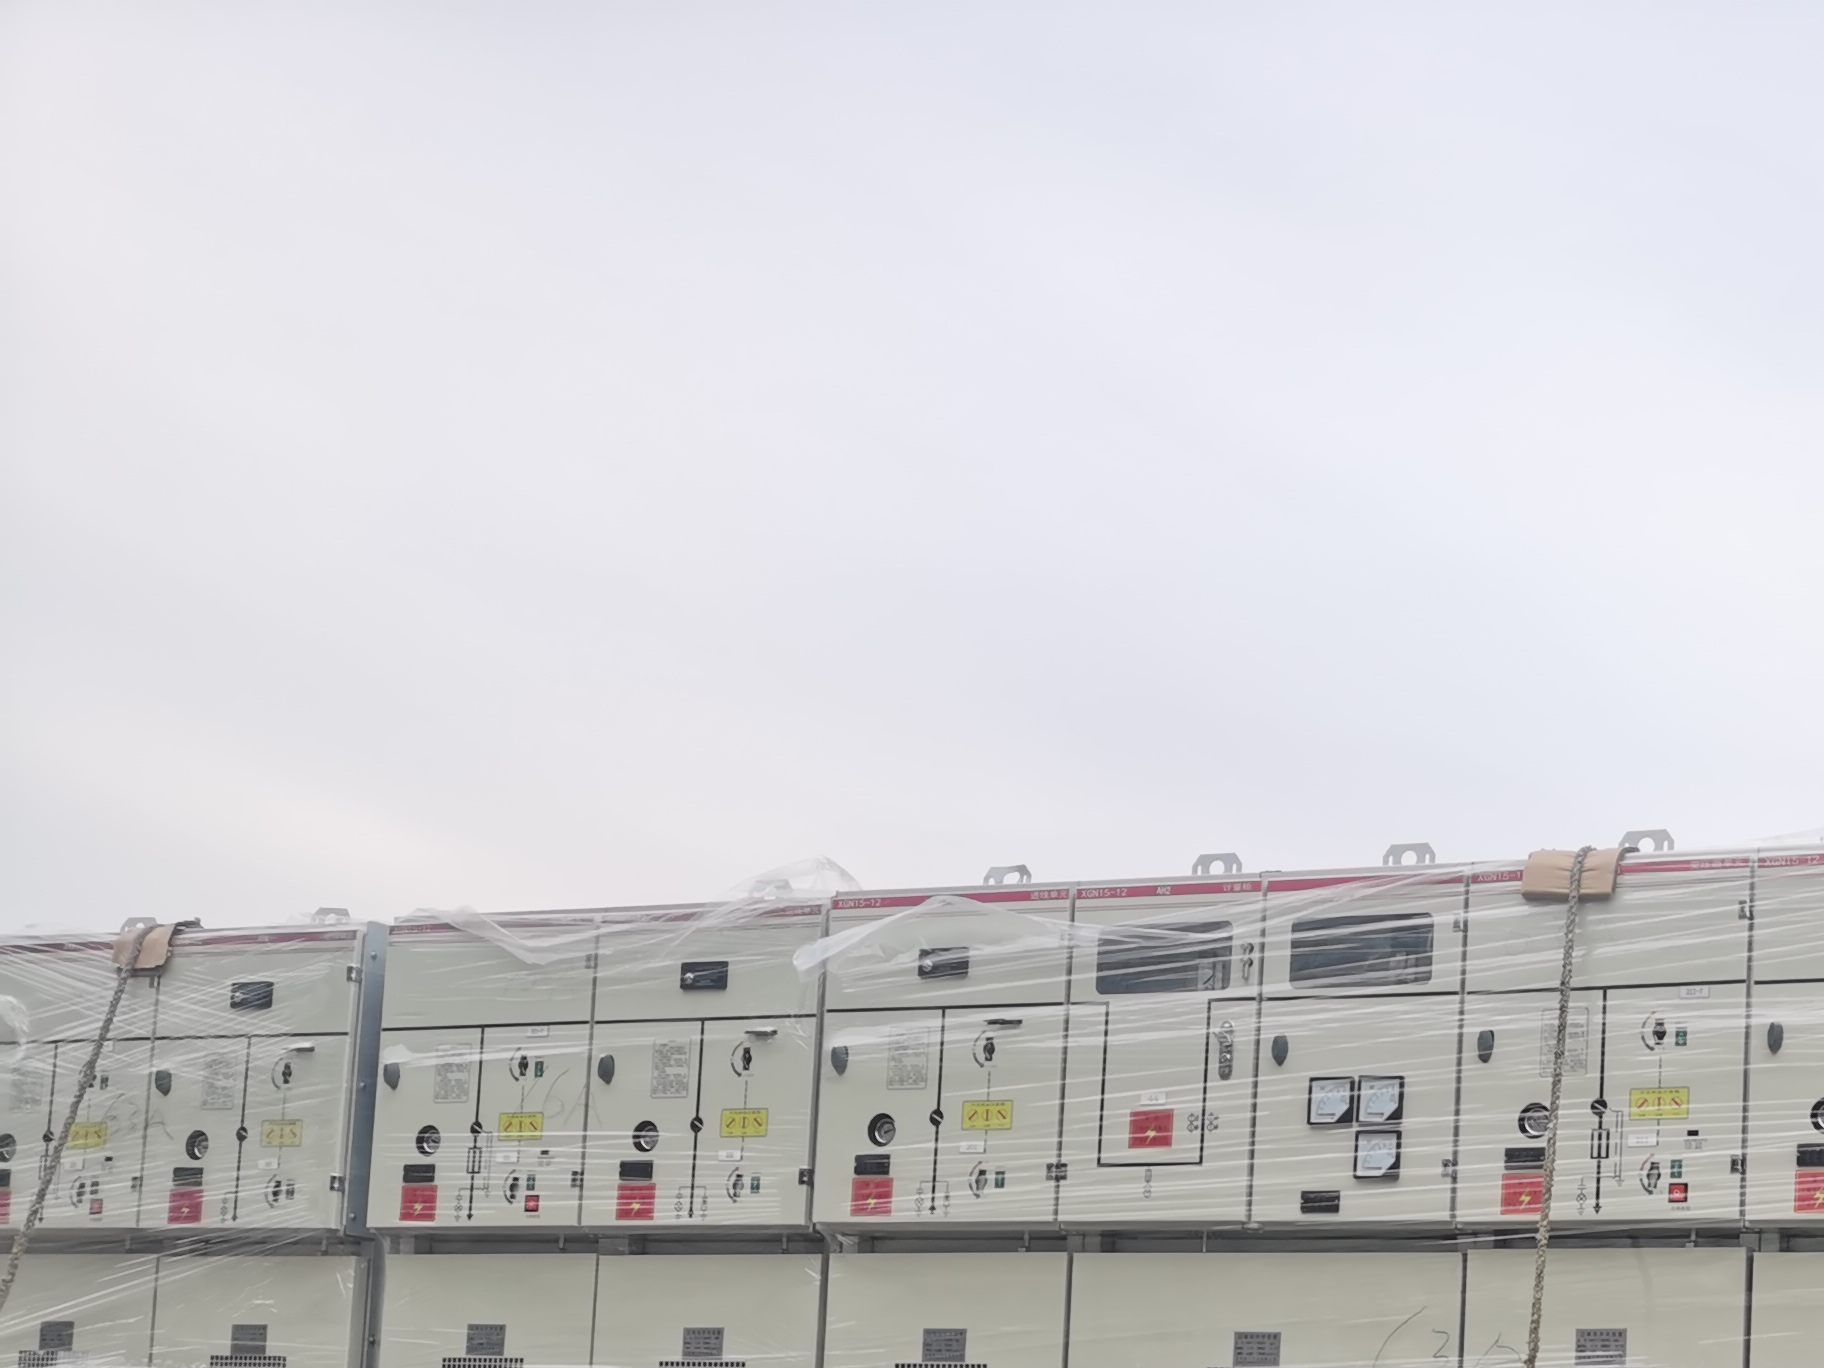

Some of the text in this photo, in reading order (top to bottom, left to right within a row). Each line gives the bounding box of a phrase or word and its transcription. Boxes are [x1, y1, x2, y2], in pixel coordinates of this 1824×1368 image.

[1764, 855, 1820, 866] XGN1512
[1476, 871, 1521, 882] XGN15-1
[1080, 888, 1127, 898] XGN15-12
[837, 898, 882, 909] XGN15-12
